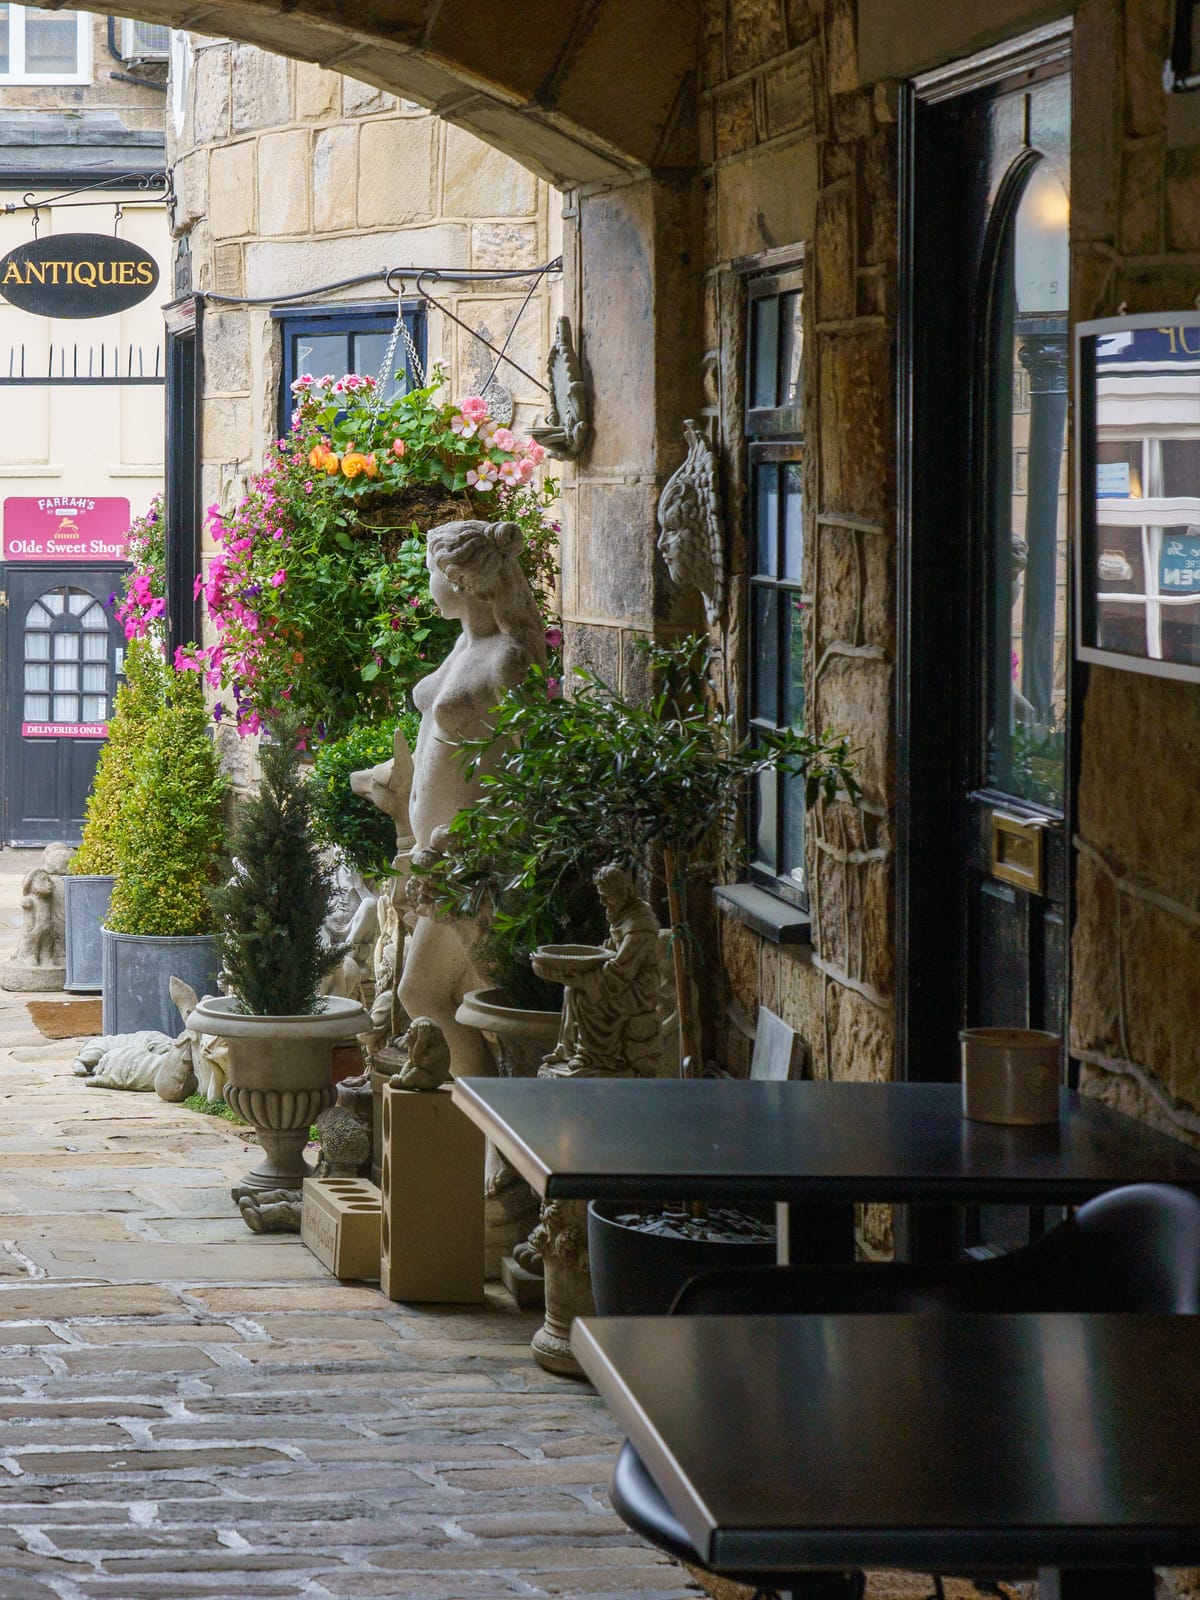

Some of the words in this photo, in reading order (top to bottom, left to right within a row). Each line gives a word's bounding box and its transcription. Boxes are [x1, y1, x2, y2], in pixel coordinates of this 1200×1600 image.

[1, 260, 154, 288] ANTIQUES
[38, 497, 95, 510] FARRAH'S
[8, 540, 44, 554] Olde
[46, 540, 87, 554] Sweet
[89, 540, 125, 557] Shop
[27, 726, 78, 734] DELIVERIES
[80, 726, 103, 734] ONLY
